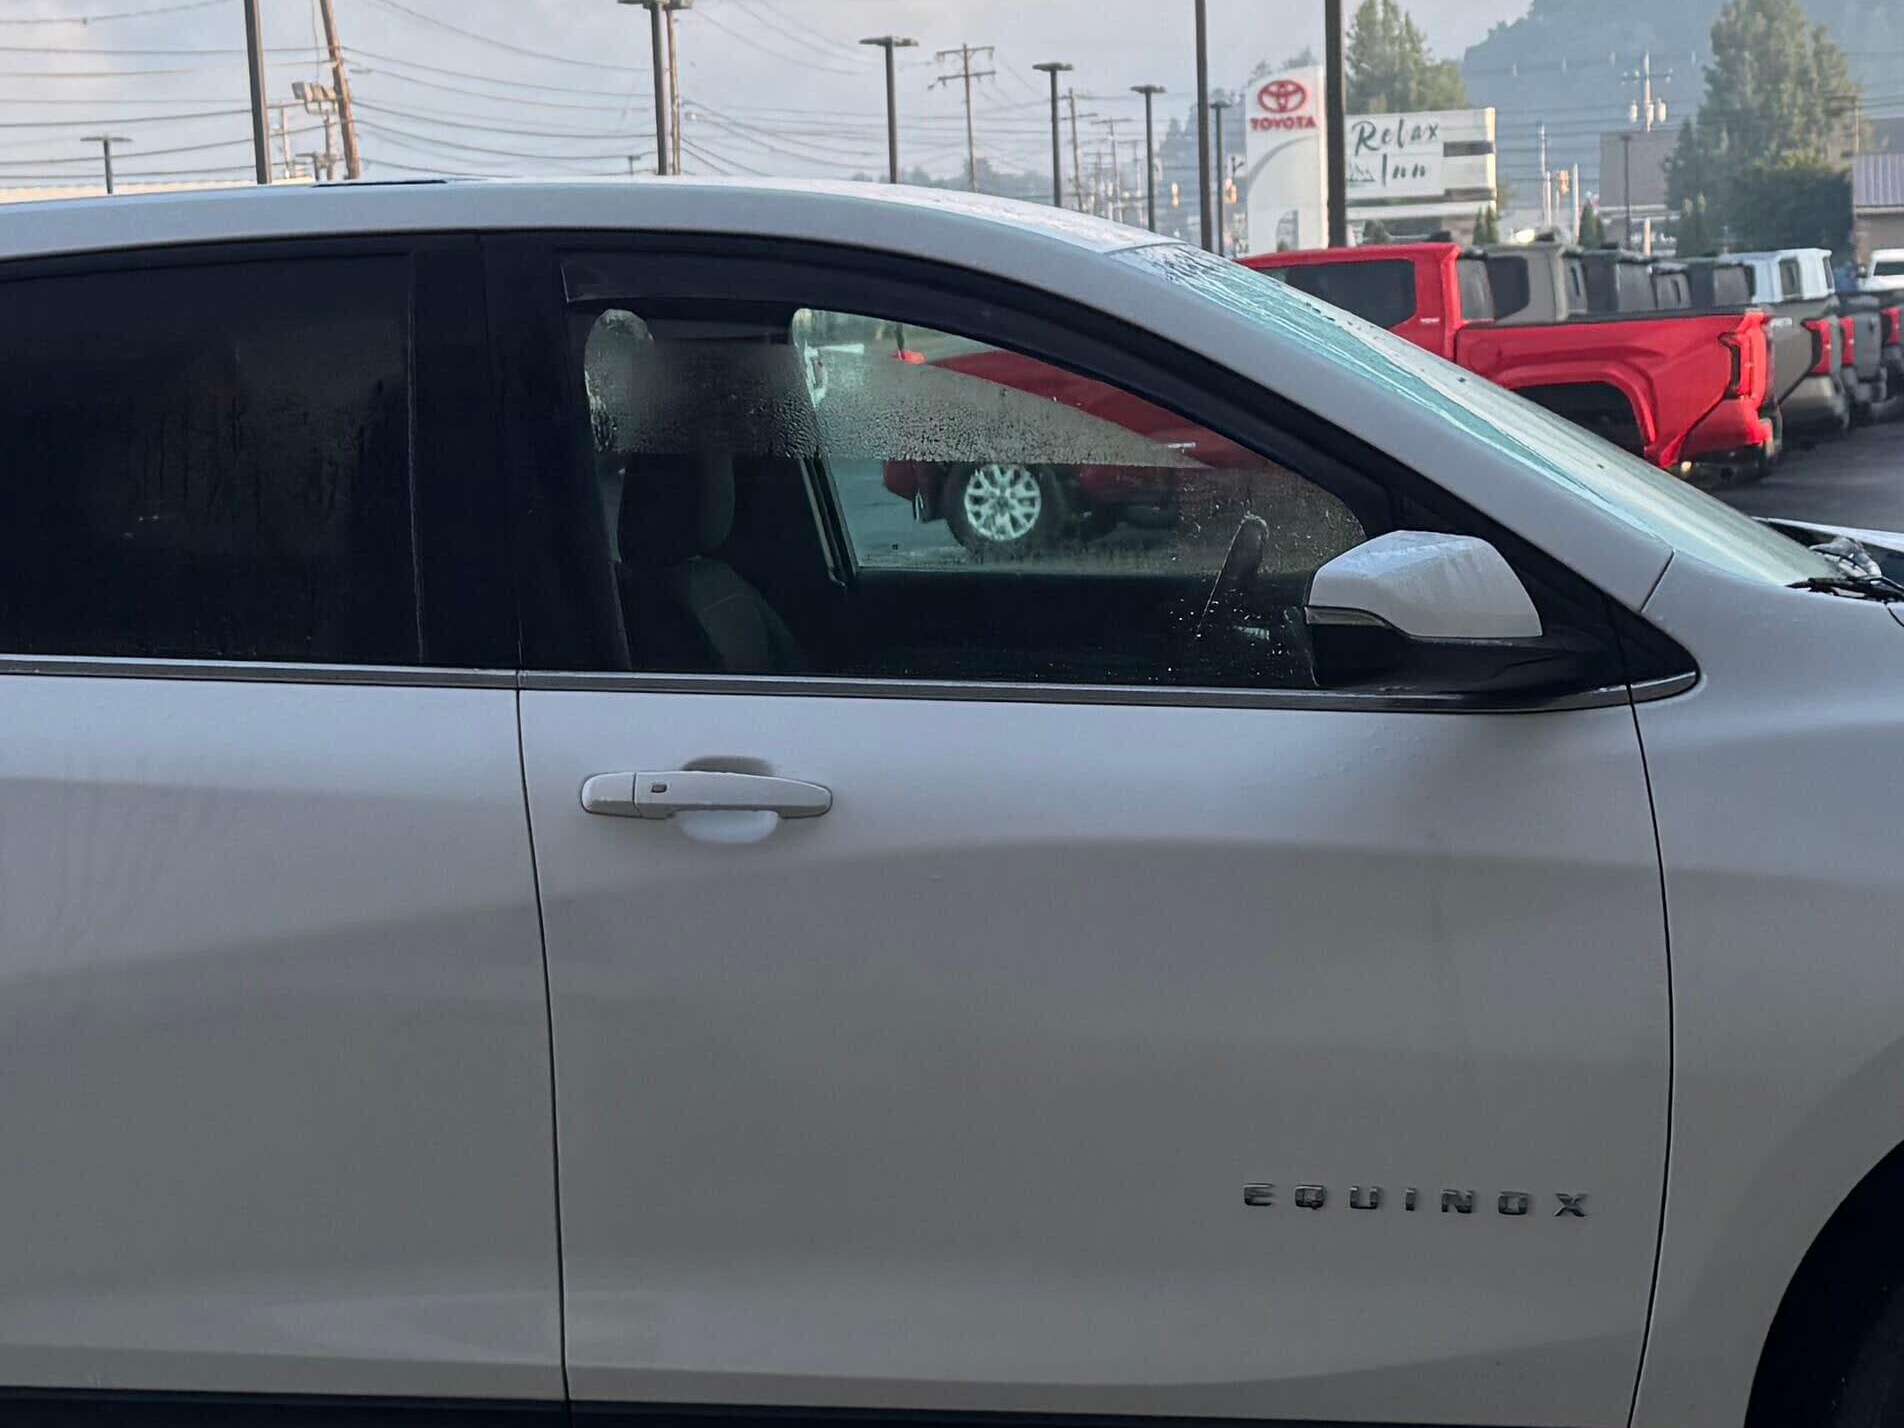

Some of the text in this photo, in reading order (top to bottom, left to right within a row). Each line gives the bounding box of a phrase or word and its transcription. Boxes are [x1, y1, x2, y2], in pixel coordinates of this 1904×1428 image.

[1250, 117, 1317, 131] TOYOTA
[1352, 119, 1440, 156] Relax
[1382, 153, 1426, 186] Inn
[1243, 1182, 1588, 1217] EQUINOX
